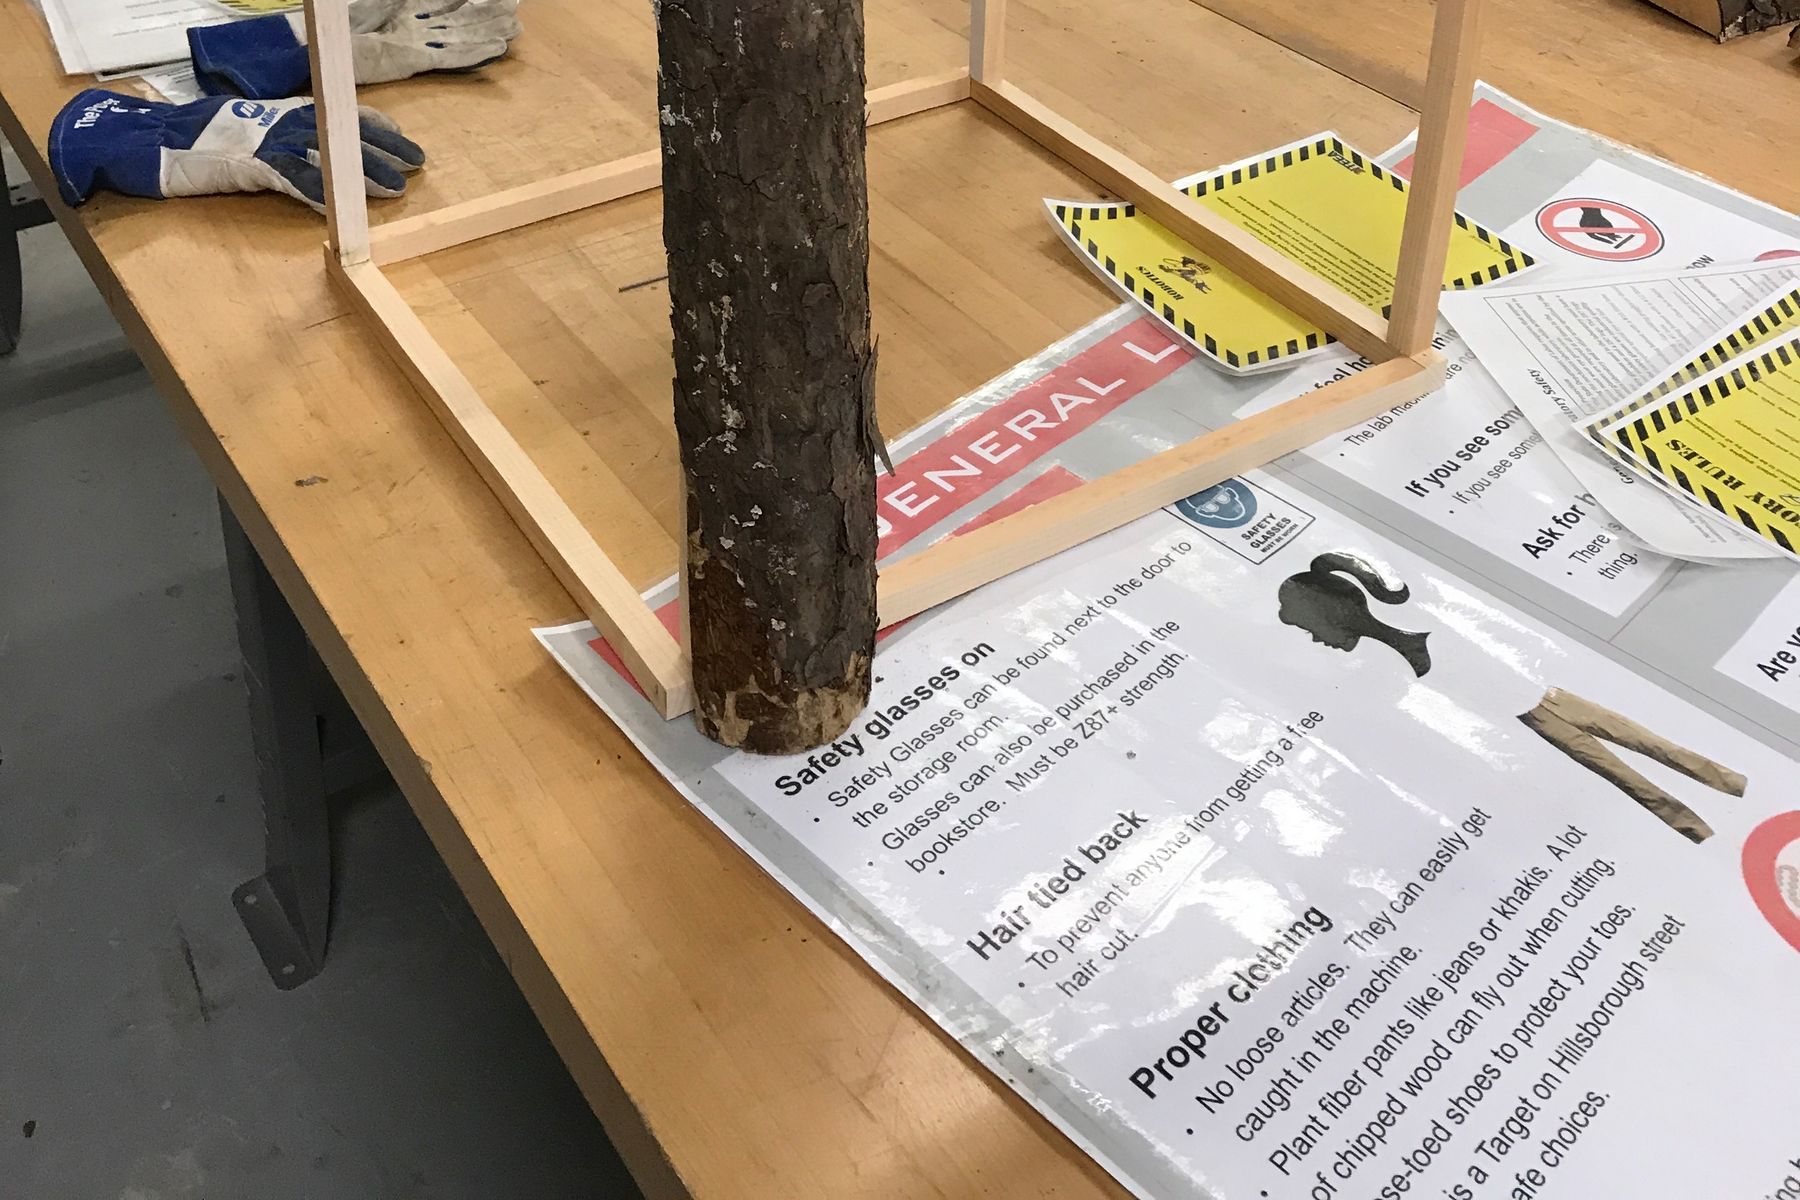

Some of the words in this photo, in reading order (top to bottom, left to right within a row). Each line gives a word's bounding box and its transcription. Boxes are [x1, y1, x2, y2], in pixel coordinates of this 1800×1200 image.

[1137, 266, 1184, 300] ROBOTICS
[1527, 368, 1555, 395] Safety
[1344, 429, 1375, 447] The
[1367, 413, 1393, 432] lab
[1404, 480, 1430, 498] If
[1423, 459, 1462, 489] you
[1455, 435, 1490, 462] see
[1452, 491, 1471, 505] If
[1465, 477, 1492, 499] you
[1487, 459, 1513, 479] see
[1665, 439, 1746, 490] RULES
[1241, 512, 1277, 540] SAFETY
[1250, 517, 1292, 549] GLASSES
[1521, 526, 1565, 560] Ask
[1551, 504, 1586, 530] for
[1745, 491, 1800, 529] ORY
[1260, 541, 1276, 553] MUST
[1568, 533, 1611, 564] There
[1597, 551, 1638, 580] thing.
[828, 760, 893, 808] Safety
[889, 706, 964, 763] Glasses
[963, 680, 998, 710] can
[992, 666, 1021, 686] be
[1017, 632, 1068, 670] found
[1064, 604, 1102, 636] next
[1097, 594, 1118, 610] to
[1113, 577, 1143, 597] the
[1141, 554, 1176, 580] door
[1171, 541, 1193, 557] to
[1756, 650, 1797, 682] Are
[774, 733, 865, 797] Safety
[864, 664, 960, 741] glasses
[961, 641, 996, 667] on
[881, 791, 961, 851] Glasses
[959, 763, 995, 793] can
[994, 734, 1033, 767] also
[1030, 715, 1057, 736] be
[1055, 651, 1139, 721] purchased
[1131, 638, 1156, 657] in
[1149, 619, 1180, 642] the
[1278, 736, 1297, 752] a
[1286, 709, 1325, 738] free
[852, 799, 888, 829] the
[888, 752, 957, 804] storage
[956, 714, 1009, 753] room.
[904, 798, 1007, 874] bookstore.
[1004, 755, 1057, 794] Must
[1051, 735, 1080, 758] be
[1072, 704, 1119, 740] Z87+
[1119, 650, 1190, 708] strength.
[1226, 749, 1285, 803] getting
[1184, 796, 1231, 833] from
[966, 904, 1032, 961] Hair
[1027, 858, 1087, 910] tied
[1077, 809, 1149, 865] back
[1129, 830, 1191, 887] anyone
[1057, 883, 1131, 955] prevent
[1491, 865, 1554, 924] khakis.
[1479, 917, 1504, 942] or
[1640, 913, 1686, 962] street
[1025, 949, 1059, 972] To
[1055, 958, 1106, 999] hair
[1101, 927, 1139, 961] cut.
[1195, 1079, 1235, 1115] No
[1226, 1024, 1284, 1082] loose
[1281, 958, 1351, 1028] articles.
[1343, 909, 1397, 953] They
[1389, 881, 1425, 913] can
[1419, 829, 1471, 882] easily
[1462, 805, 1492, 838] get
[1437, 938, 1486, 995] jeans
[1128, 1000, 1231, 1099] Proper
[1227, 905, 1334, 1004] clothing
[1311, 1170, 1338, 1200] of
[1333, 1092, 1409, 1180] chipped
[1399, 1038, 1453, 1098] wood
[1446, 1005, 1485, 1045] can
[1471, 983, 1507, 1021] fly
[1496, 950, 1531, 989] out
[1520, 905, 1568, 959] when
[1561, 857, 1616, 910] cutting.
[1403, 982, 1444, 1021] like
[1548, 960, 1649, 1075] Hillsborough
[1235, 1069, 1305, 1143] caught
[1294, 1046, 1323, 1073] in
[1313, 1016, 1351, 1050] the
[1344, 946, 1424, 1022] machine.
[1362, 1017, 1416, 1078] pants
[1374, 1119, 1452, 1200] se-toed
[1446, 1064, 1502, 1126] shoes
[1490, 1041, 1519, 1066] to
[1512, 976, 1573, 1049] protect
[1566, 938, 1605, 985] your
[1594, 901, 1637, 945] toes.
[1320, 1067, 1369, 1122] fiber
[1533, 1072, 1562, 1101] on
[1268, 1115, 1330, 1177] Plant
[1474, 1096, 1542, 1163] Target
[1540, 1090, 1611, 1169] choices.
[1467, 1164, 1490, 1185] a
